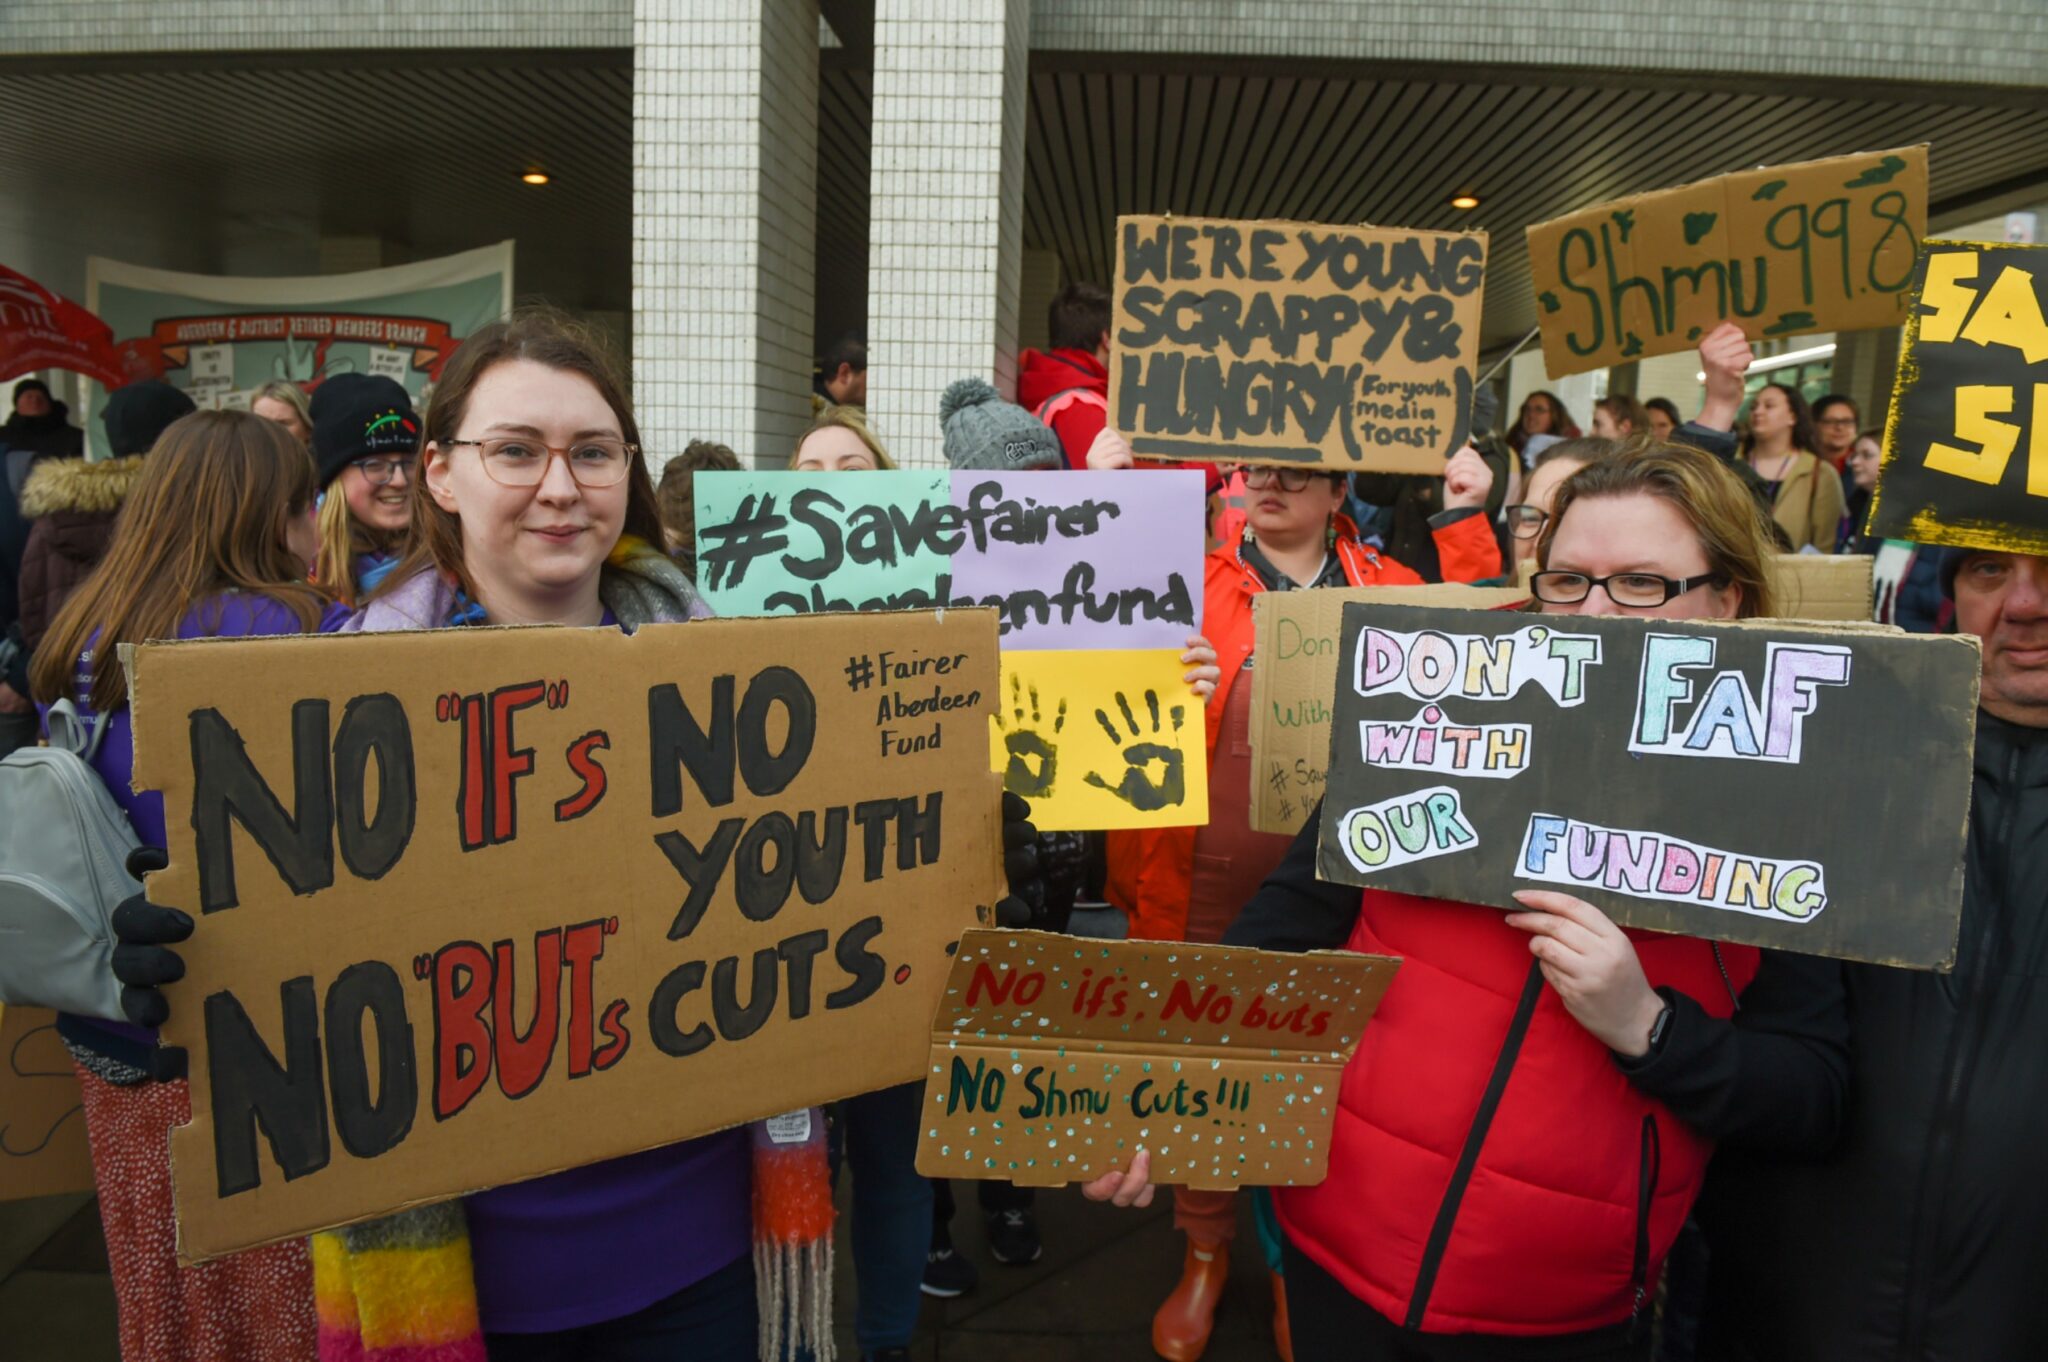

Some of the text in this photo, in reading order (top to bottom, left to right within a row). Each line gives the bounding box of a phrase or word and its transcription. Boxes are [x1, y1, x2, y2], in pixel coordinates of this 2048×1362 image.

[1293, 231, 1483, 296] YOUNG
[1558, 191, 1918, 357] Shmu 99.8
[289, 317, 332, 335] RETIRED
[335, 319, 384, 338] MEMBERS
[386, 322, 428, 343] BRANCH
[1118, 286, 1463, 363] SCRAPPY &
[1117, 351, 1346, 444] HUNGRY
[1356, 399, 1436, 421] media
[1360, 420, 1442, 448] toast
[876, 688, 980, 725] Aberdeen
[1362, 626, 1851, 758] DON'T FAF
[880, 724, 941, 757] Fund
[189, 693, 417, 914] NO
[648, 665, 816, 817] NO
[654, 791, 943, 940] YOUTH
[1347, 791, 1826, 917] OUR FUNDING
[1160, 979, 1232, 1025] No
[1240, 995, 1331, 1036] buts
[204, 961, 415, 1199] NO
[1019, 1066, 1110, 1119] Shmu
